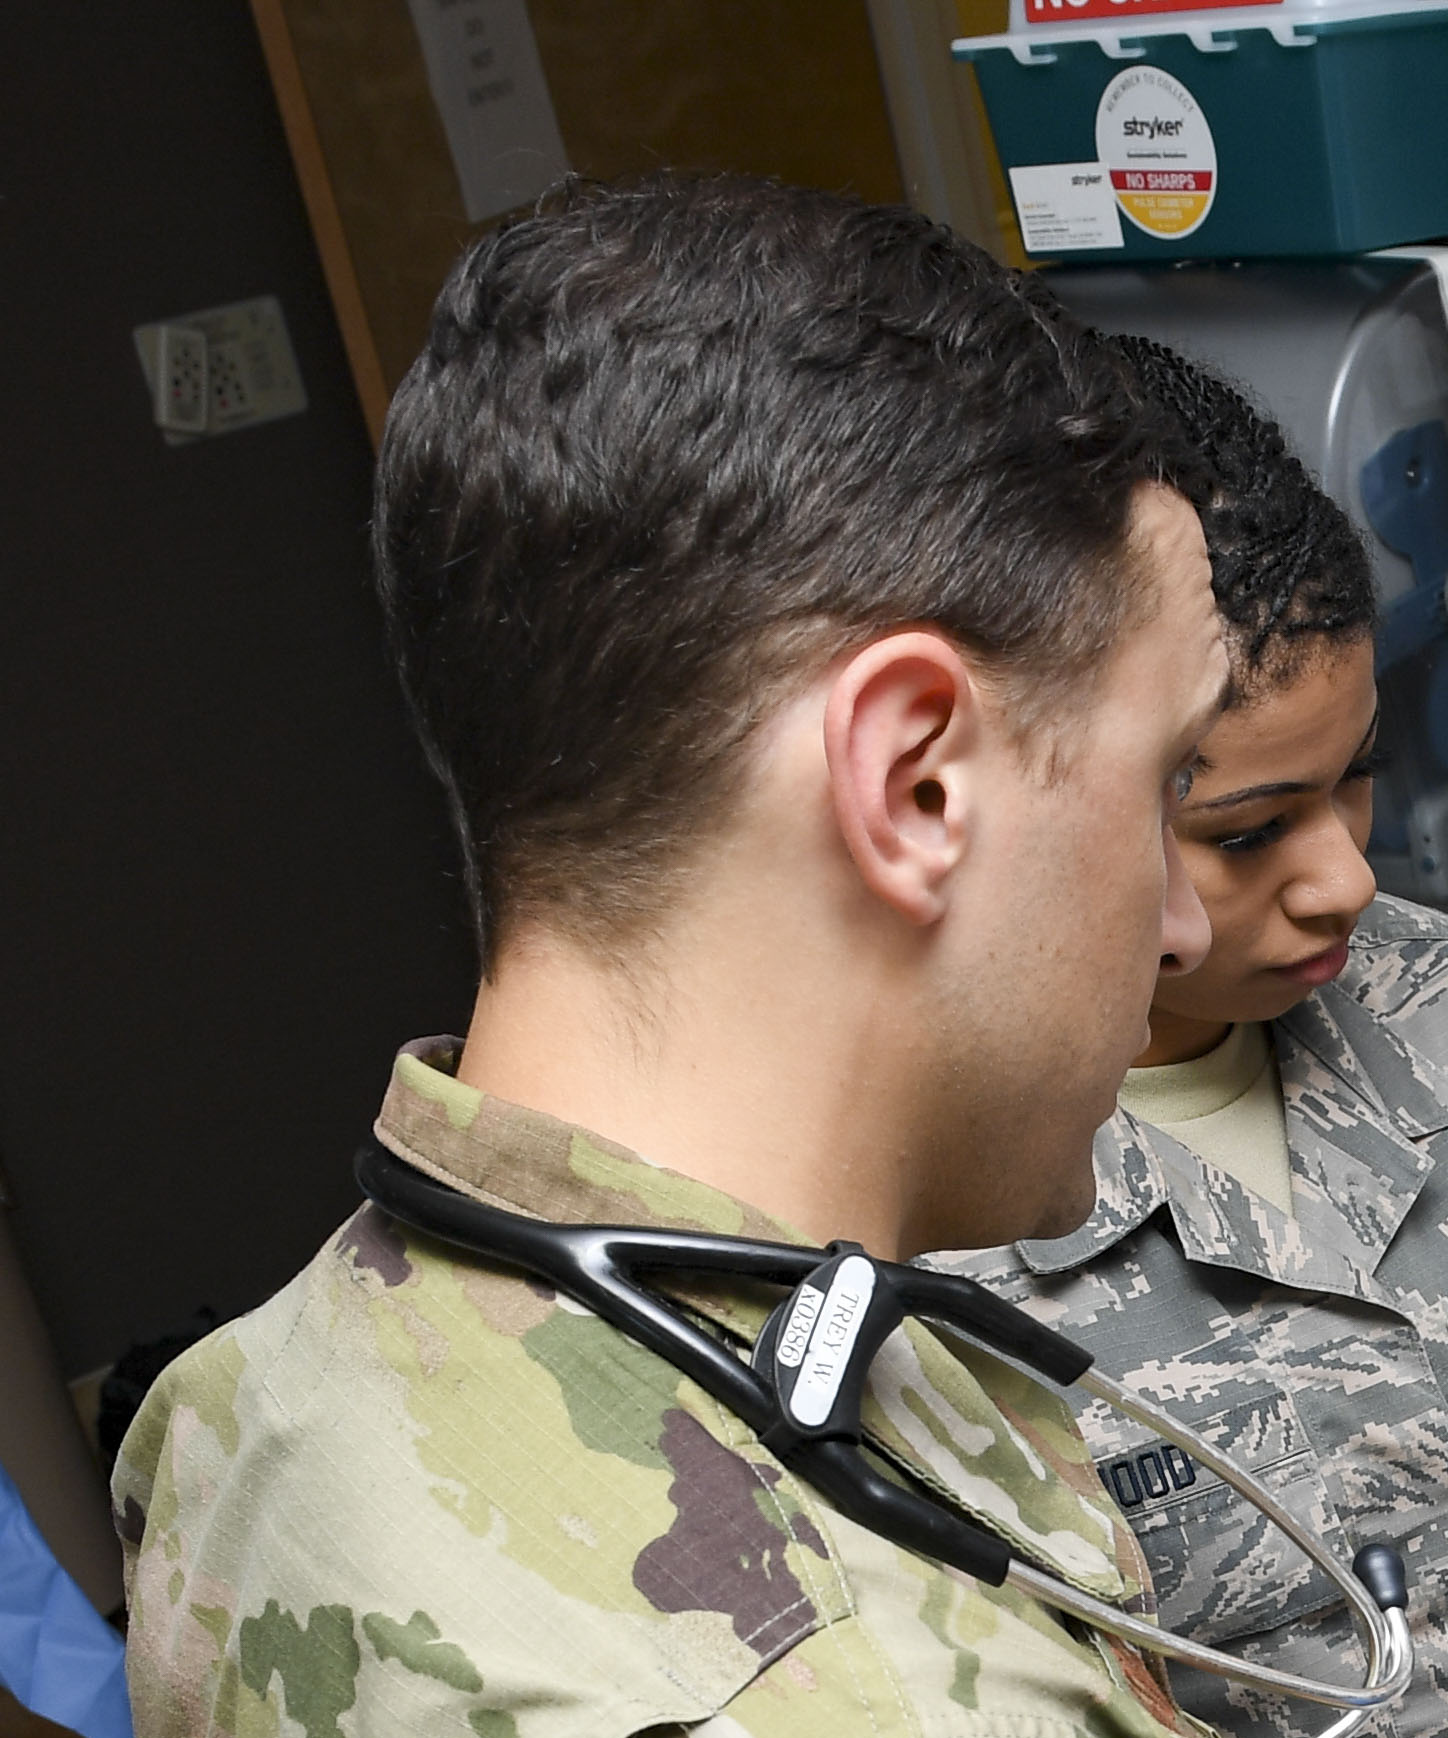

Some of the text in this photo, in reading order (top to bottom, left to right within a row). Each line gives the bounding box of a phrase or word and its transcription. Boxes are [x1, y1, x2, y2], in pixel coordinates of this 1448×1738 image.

[1123, 116, 1184, 139] stryker
[1125, 173, 1196, 189] NO SHARPS
[823, 1293, 860, 1356] TREY
[1097, 1445, 1196, 1508] OOD
